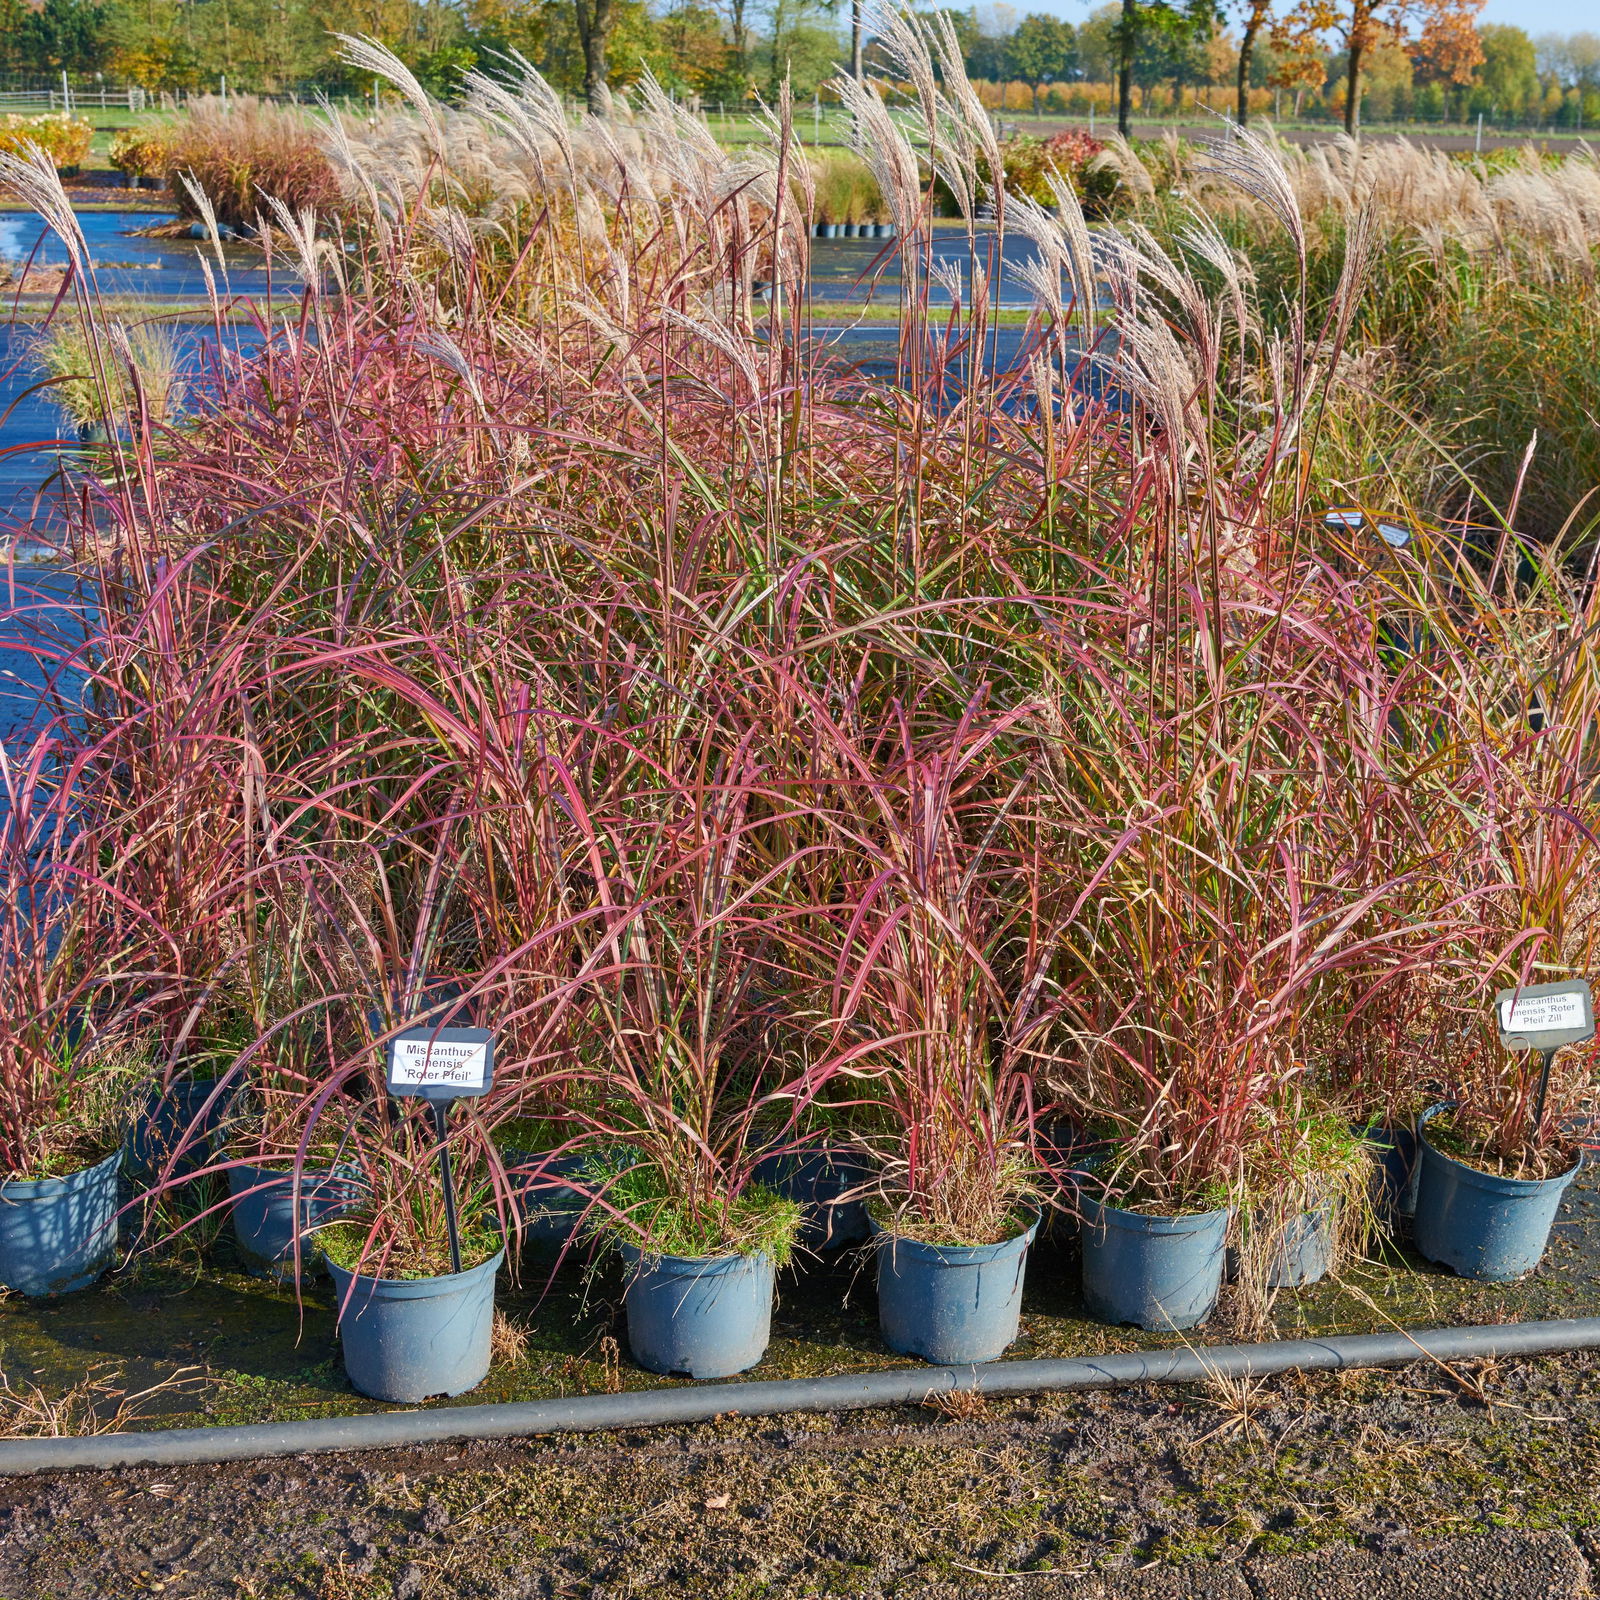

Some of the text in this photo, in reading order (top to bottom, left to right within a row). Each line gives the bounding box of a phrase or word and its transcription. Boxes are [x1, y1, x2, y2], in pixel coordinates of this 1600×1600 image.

[1508, 1004, 1575, 1017] inensis 'Roter
[1523, 1013, 1562, 1025] Pfeil' Zill
[442, 1070, 471, 1081] Pfeil'
